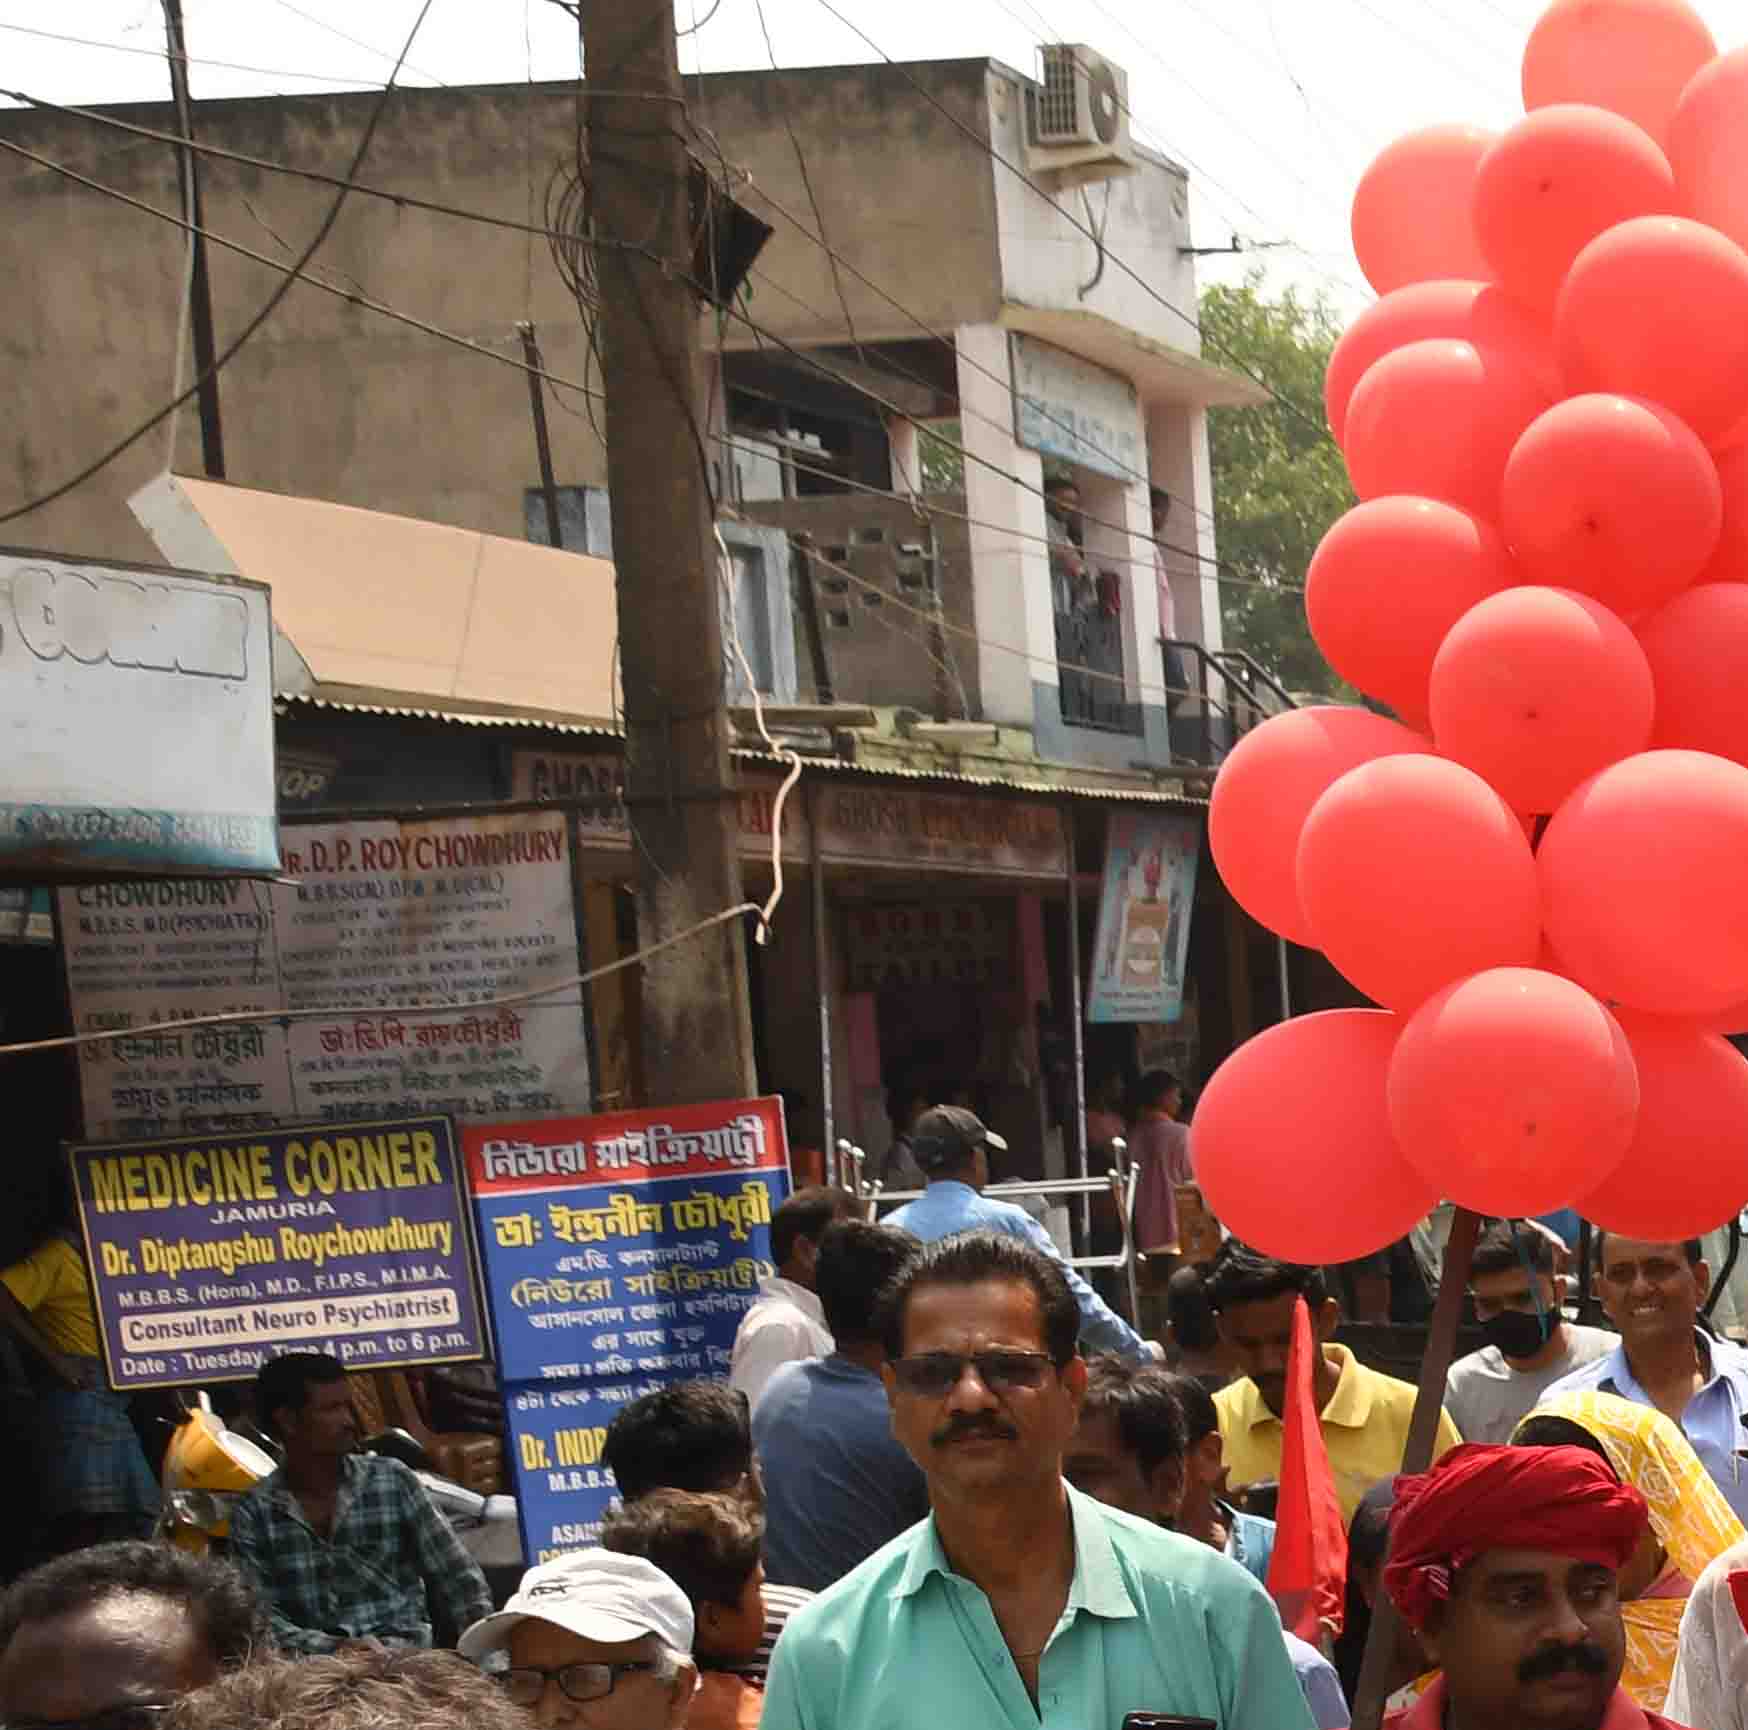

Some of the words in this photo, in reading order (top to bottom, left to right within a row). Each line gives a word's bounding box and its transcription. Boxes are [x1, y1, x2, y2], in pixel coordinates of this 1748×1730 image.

[90, 1143, 280, 1214] MEDICINE
[283, 1130, 443, 1199] CORNER
[481, 1138, 587, 1182] নিউরো
[210, 1200, 337, 1226] JAMURIA
[101, 1240, 137, 1277] Dr.
[142, 1229, 276, 1280] Diptangshu
[279, 1217, 454, 1267] Roychowdhury
[128, 1310, 248, 1342] Consultant
[253, 1302, 318, 1333] Neuro
[323, 1295, 451, 1329] Psychiatrist
[121, 1356, 167, 1377] Date
[386, 1334, 407, 1354] to
[411, 1332, 424, 1352] 6
[427, 1329, 472, 1354] p.m.
[519, 1433, 553, 1471] Dr.
[554, 1427, 608, 1467] INDR
